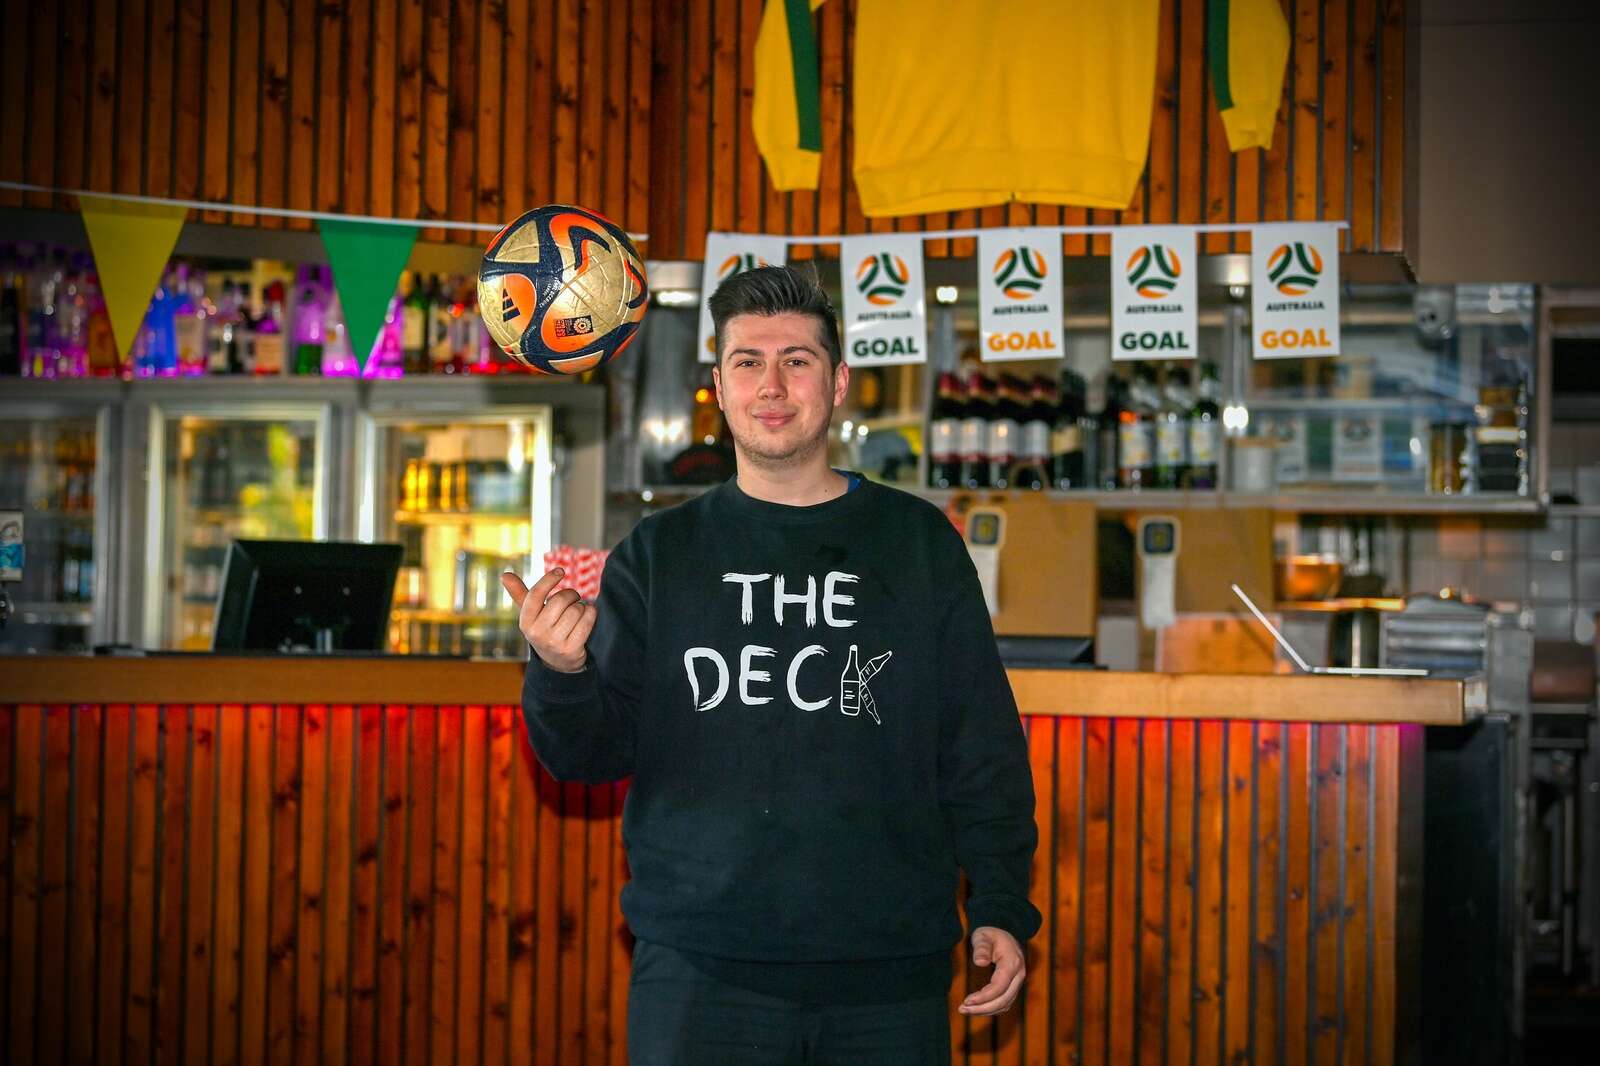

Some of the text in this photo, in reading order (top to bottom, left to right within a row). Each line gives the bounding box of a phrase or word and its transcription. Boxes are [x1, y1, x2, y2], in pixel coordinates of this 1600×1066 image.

[857, 310, 912, 321] AUSTRALIA
[992, 304, 1049, 315] AUSTRALIA
[1125, 303, 1183, 314] AUSTRALIA
[1266, 301, 1324, 312] AUSTRALIA
[853, 337, 919, 357] GOAL
[988, 330, 1056, 352] GOAL
[1120, 331, 1189, 350] GOAL
[1261, 328, 1332, 349] GOAL
[721, 571, 861, 628] THE
